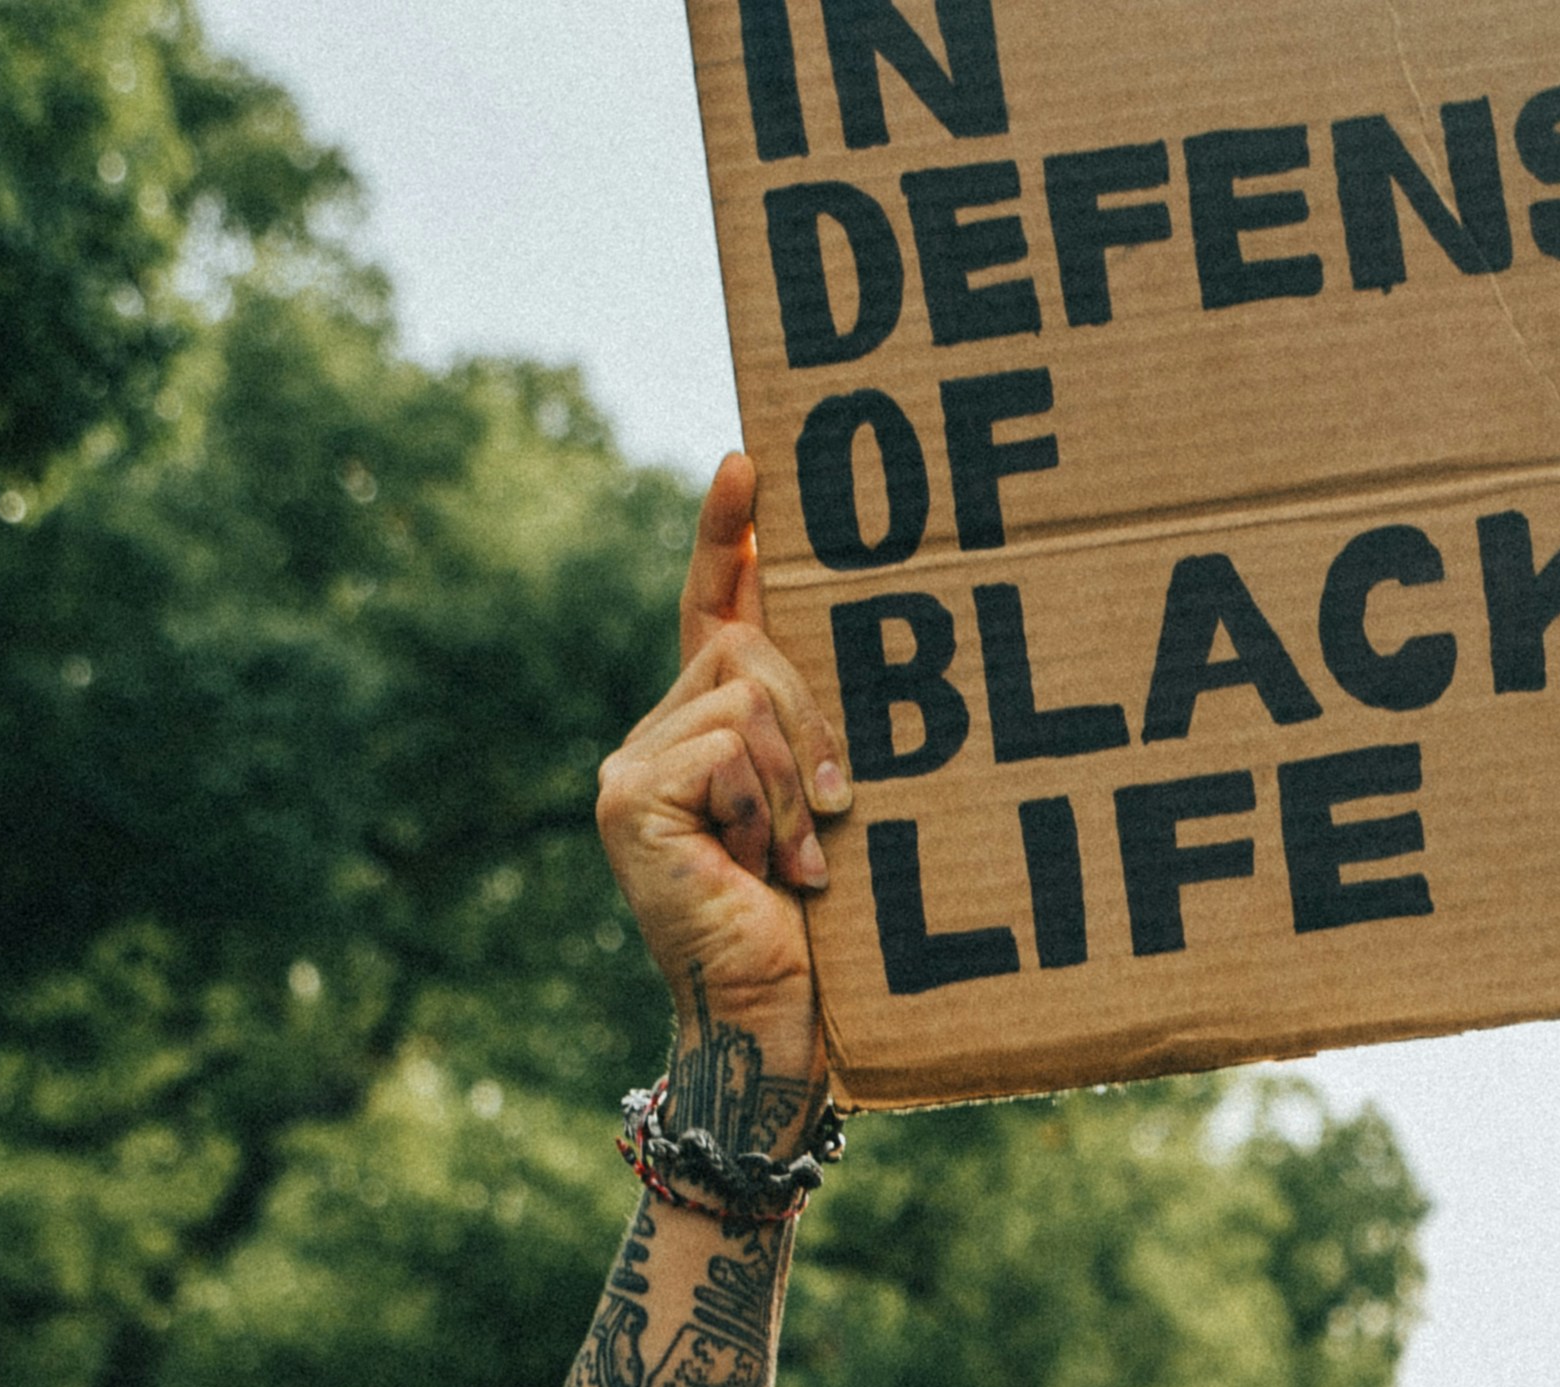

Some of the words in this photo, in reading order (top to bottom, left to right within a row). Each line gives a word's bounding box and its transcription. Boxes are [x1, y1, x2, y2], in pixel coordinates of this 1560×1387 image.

[742, 0, 1010, 161] IN
[795, 367, 1059, 571] OF
[867, 742, 1434, 995] LIFE
